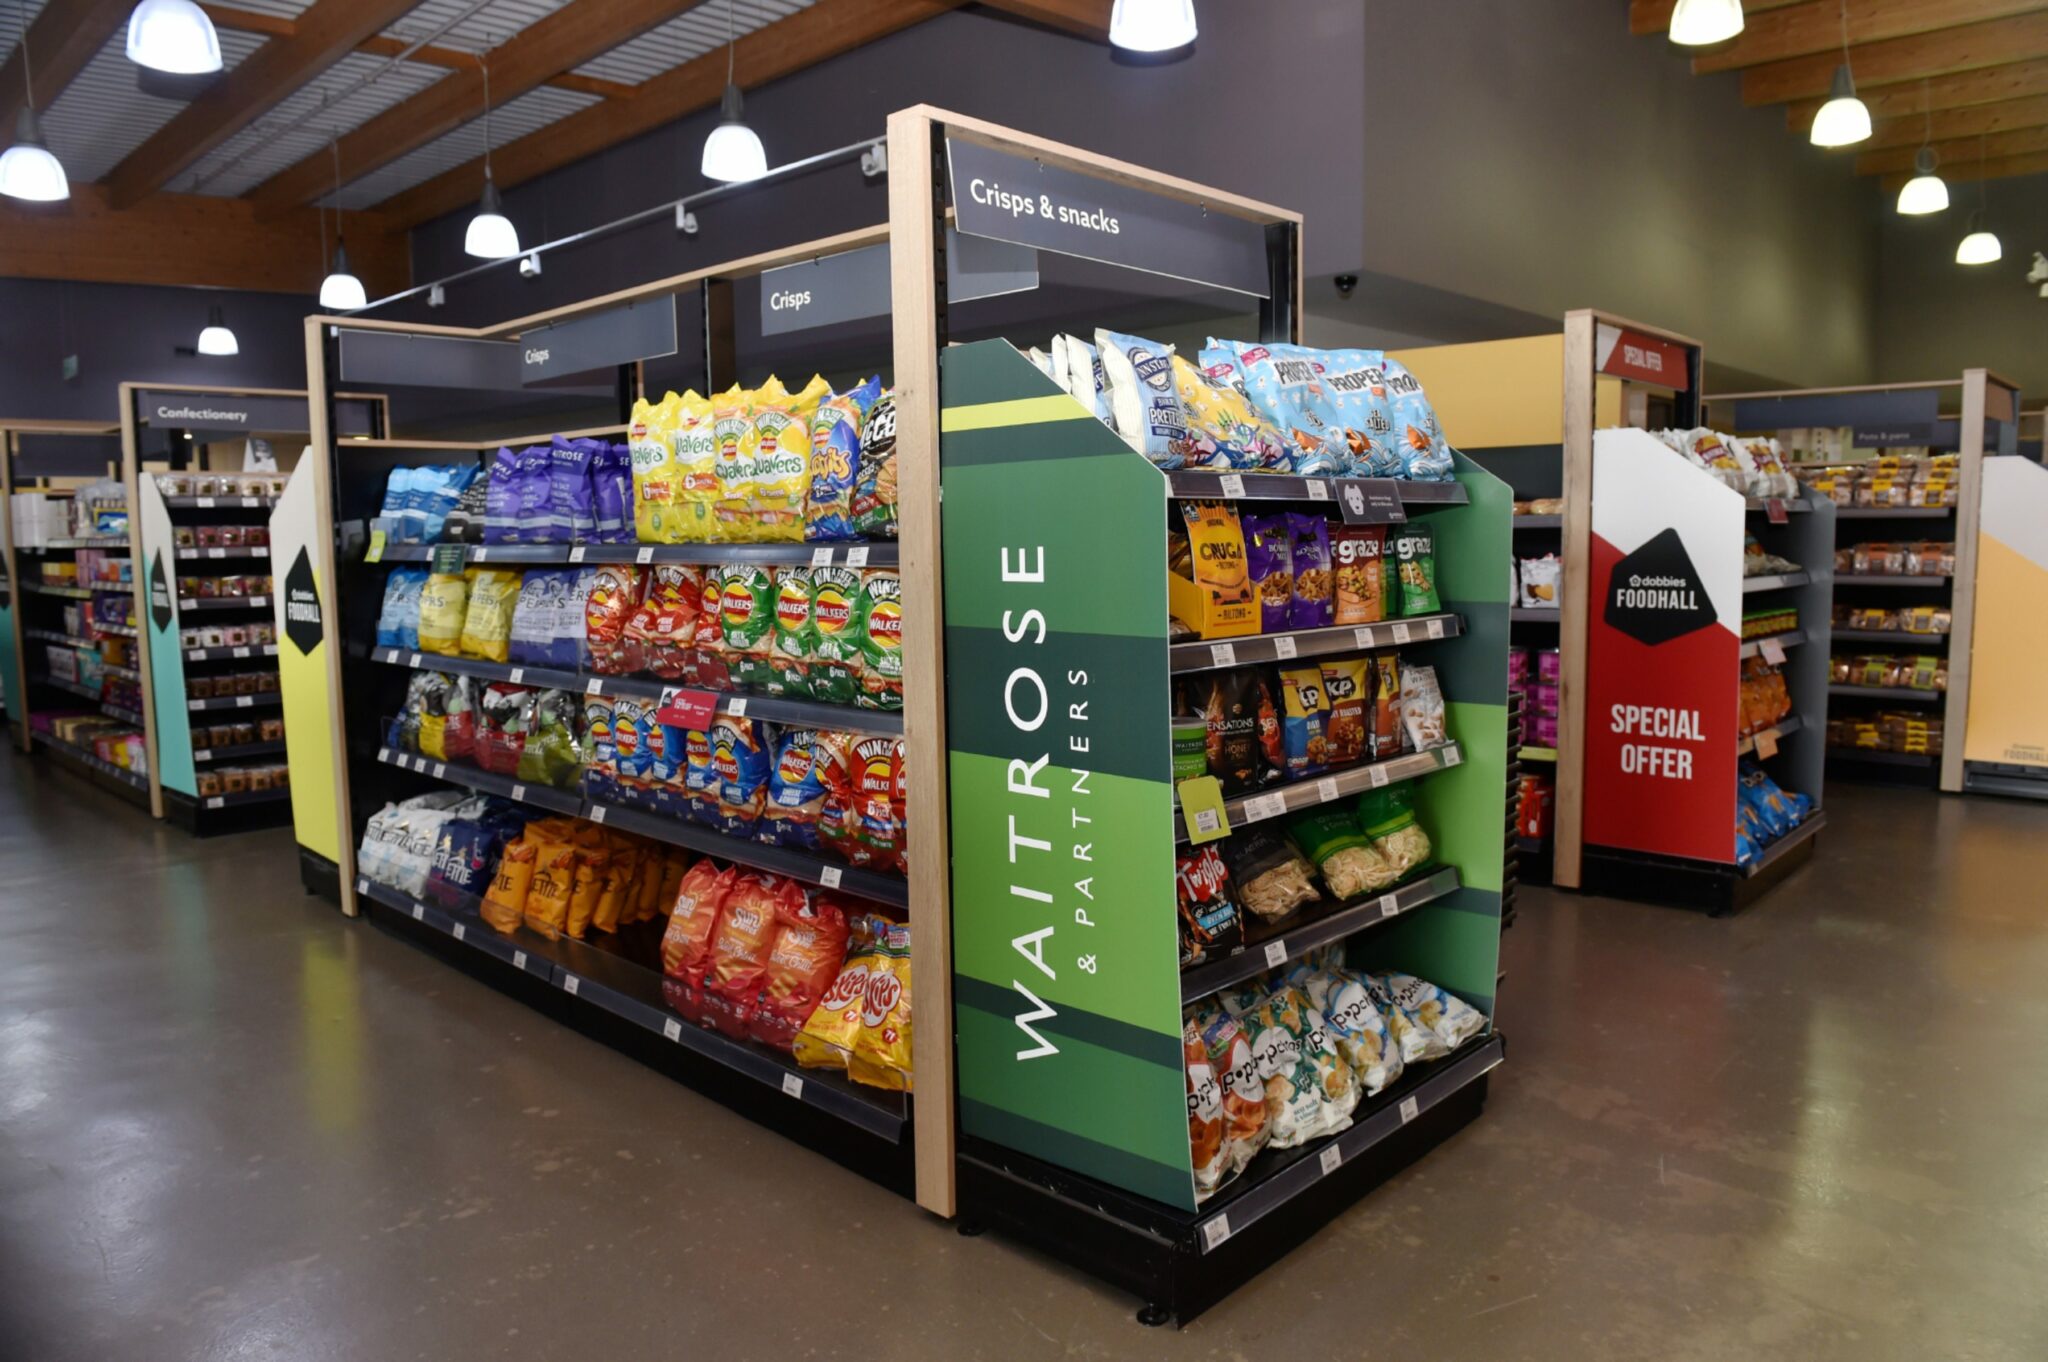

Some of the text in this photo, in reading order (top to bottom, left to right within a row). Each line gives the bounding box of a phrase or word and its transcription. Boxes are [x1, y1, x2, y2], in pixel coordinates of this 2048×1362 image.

[970, 179, 1120, 234] Crisps & snacks
[770, 289, 811, 311] Crisps
[525, 349, 549, 364] Crisps
[1327, 368, 1384, 391] PROPER
[158, 406, 247, 423] Confectionery
[1200, 541, 1243, 560] CRUGA
[1339, 539, 1379, 564] graze
[1397, 537, 1431, 560] graze
[1641, 576, 1686, 588] dobbies
[724, 598, 752, 610] WALKERS
[778, 600, 809, 615] WALKERS
[1616, 589, 1698, 610] FOODHALL
[816, 605, 849, 619] WALKERS
[870, 617, 901, 632] WALKE
[1206, 717, 1254, 731] ENSATIONS
[1611, 704, 1706, 741] SPECIAL
[1621, 744, 1692, 780] OFFER
[863, 778, 890, 791] WALK
[1001, 545, 1060, 1061] WAITROSE
[1068, 669, 1097, 974] & PARTNERS
